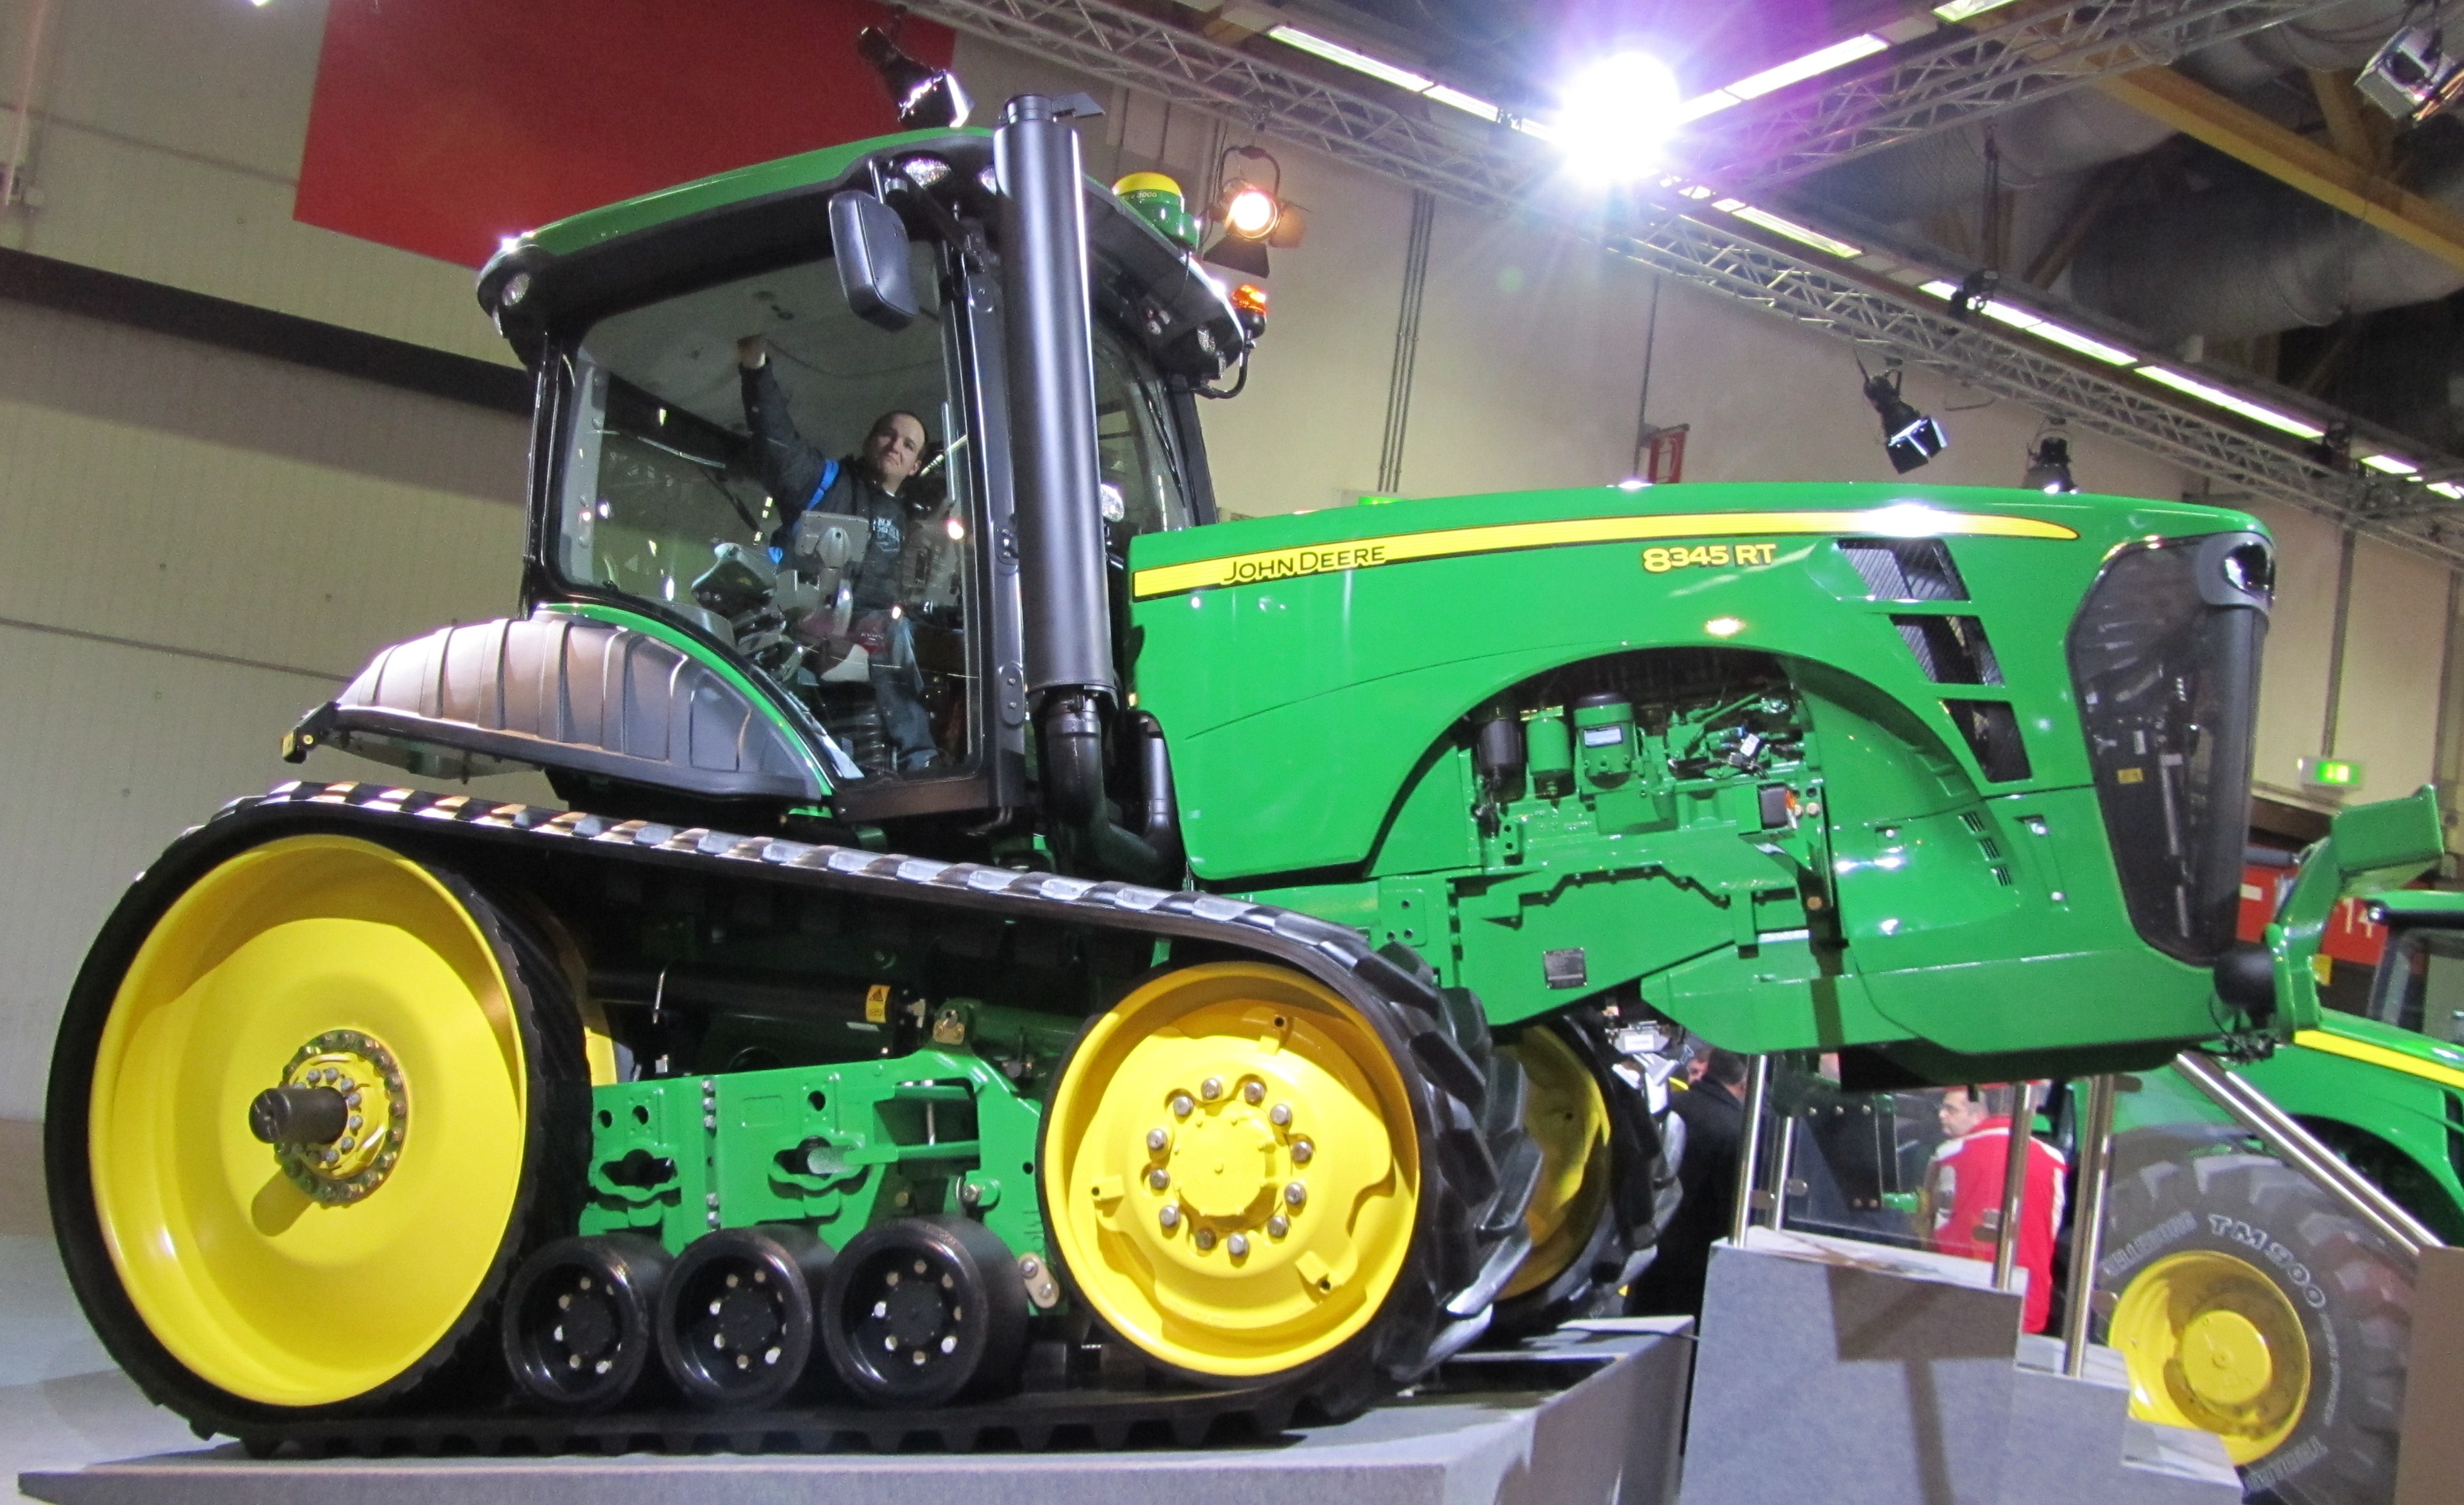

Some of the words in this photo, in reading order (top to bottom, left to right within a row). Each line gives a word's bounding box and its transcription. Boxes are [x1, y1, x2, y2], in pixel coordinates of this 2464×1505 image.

[1224, 557, 1293, 582] JOHN
[1300, 546, 1385, 571] DEERE
[1643, 545, 1729, 572] 8345
[1734, 544, 1777, 566] RT
